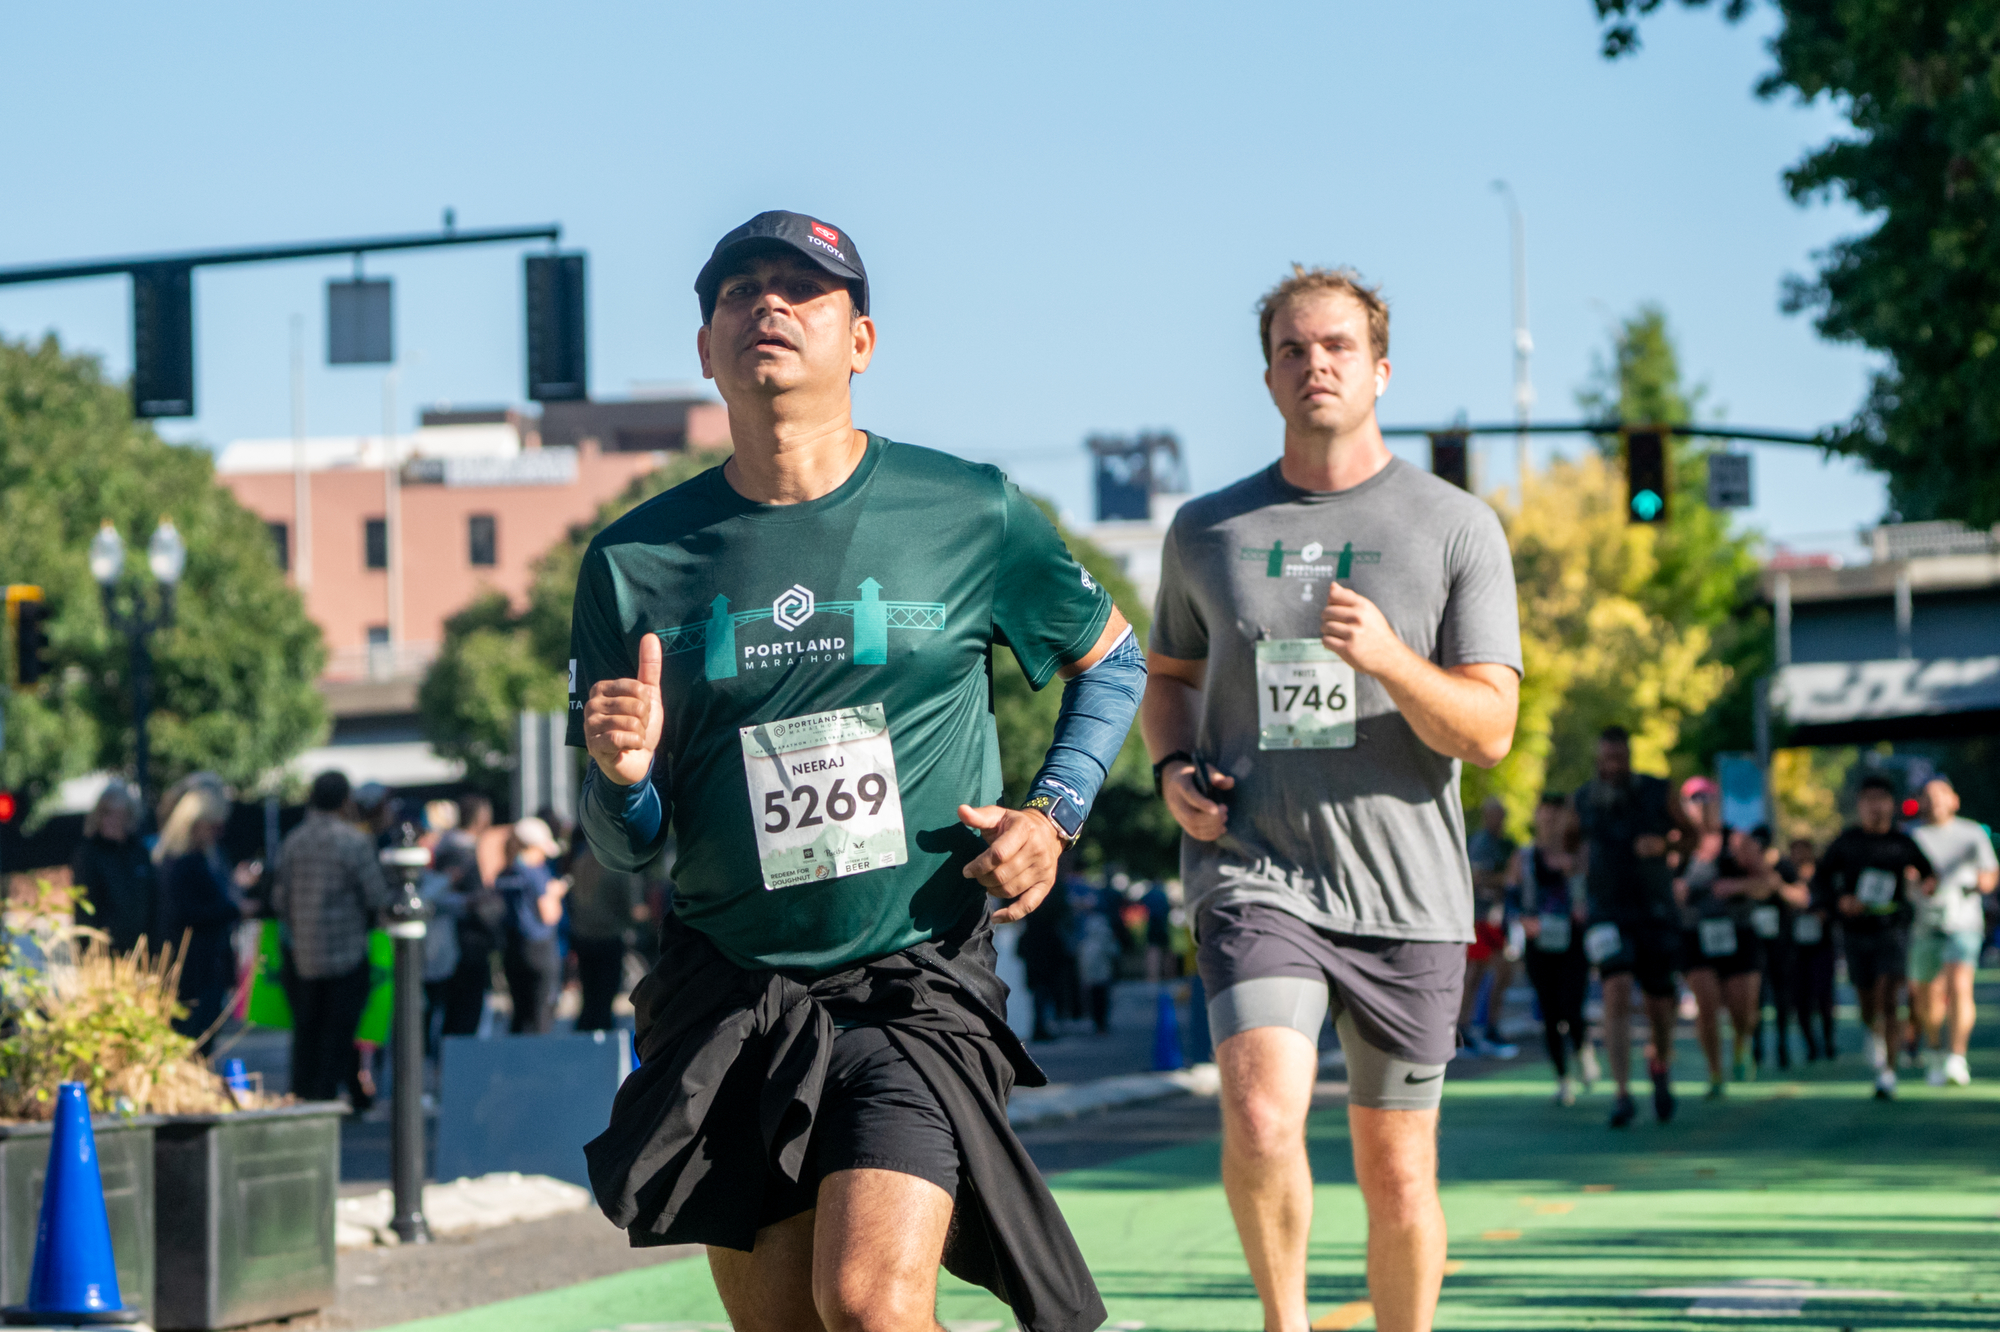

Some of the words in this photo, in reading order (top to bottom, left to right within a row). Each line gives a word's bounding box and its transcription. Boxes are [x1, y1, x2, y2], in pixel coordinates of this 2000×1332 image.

[807, 235, 845, 261] TOYOTA
[744, 637, 846, 658] PORTLAND
[745, 652, 846, 670] MARATHON
[569, 700, 584, 710] TA
[1268, 684, 1347, 712] 1746
[788, 715, 838, 730] PORTLAND
[792, 756, 845, 776] NEERAJ
[764, 773, 888, 834] 5269
[770, 870, 796, 880] REDEEM
[845, 861, 870, 873] BEER
[772, 874, 811, 887] DOUGHNUT
